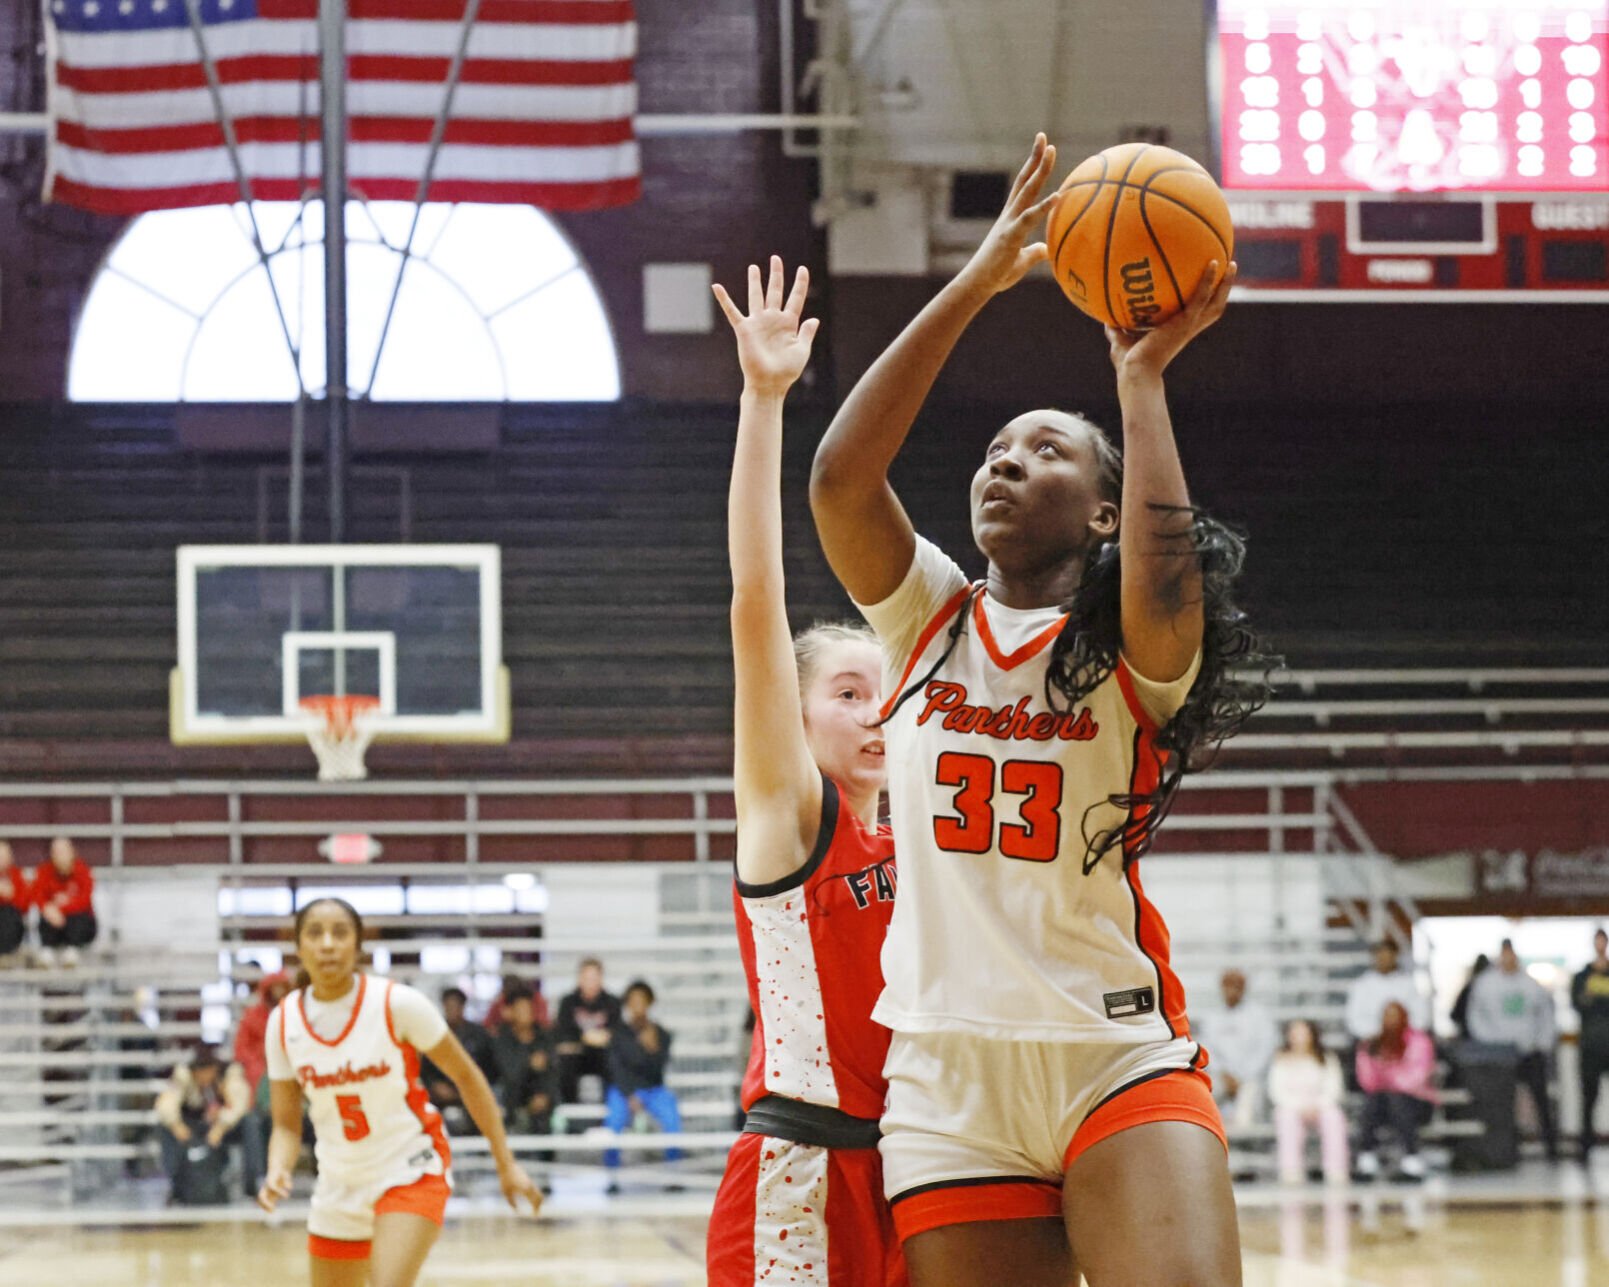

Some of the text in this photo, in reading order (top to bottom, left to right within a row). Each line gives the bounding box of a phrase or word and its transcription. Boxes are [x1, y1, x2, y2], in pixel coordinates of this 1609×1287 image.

[916, 680, 1099, 741] Panthers
[932, 751, 1064, 863] 33
[297, 1059, 391, 1090] Panthers
[335, 1095, 371, 1143] 5
